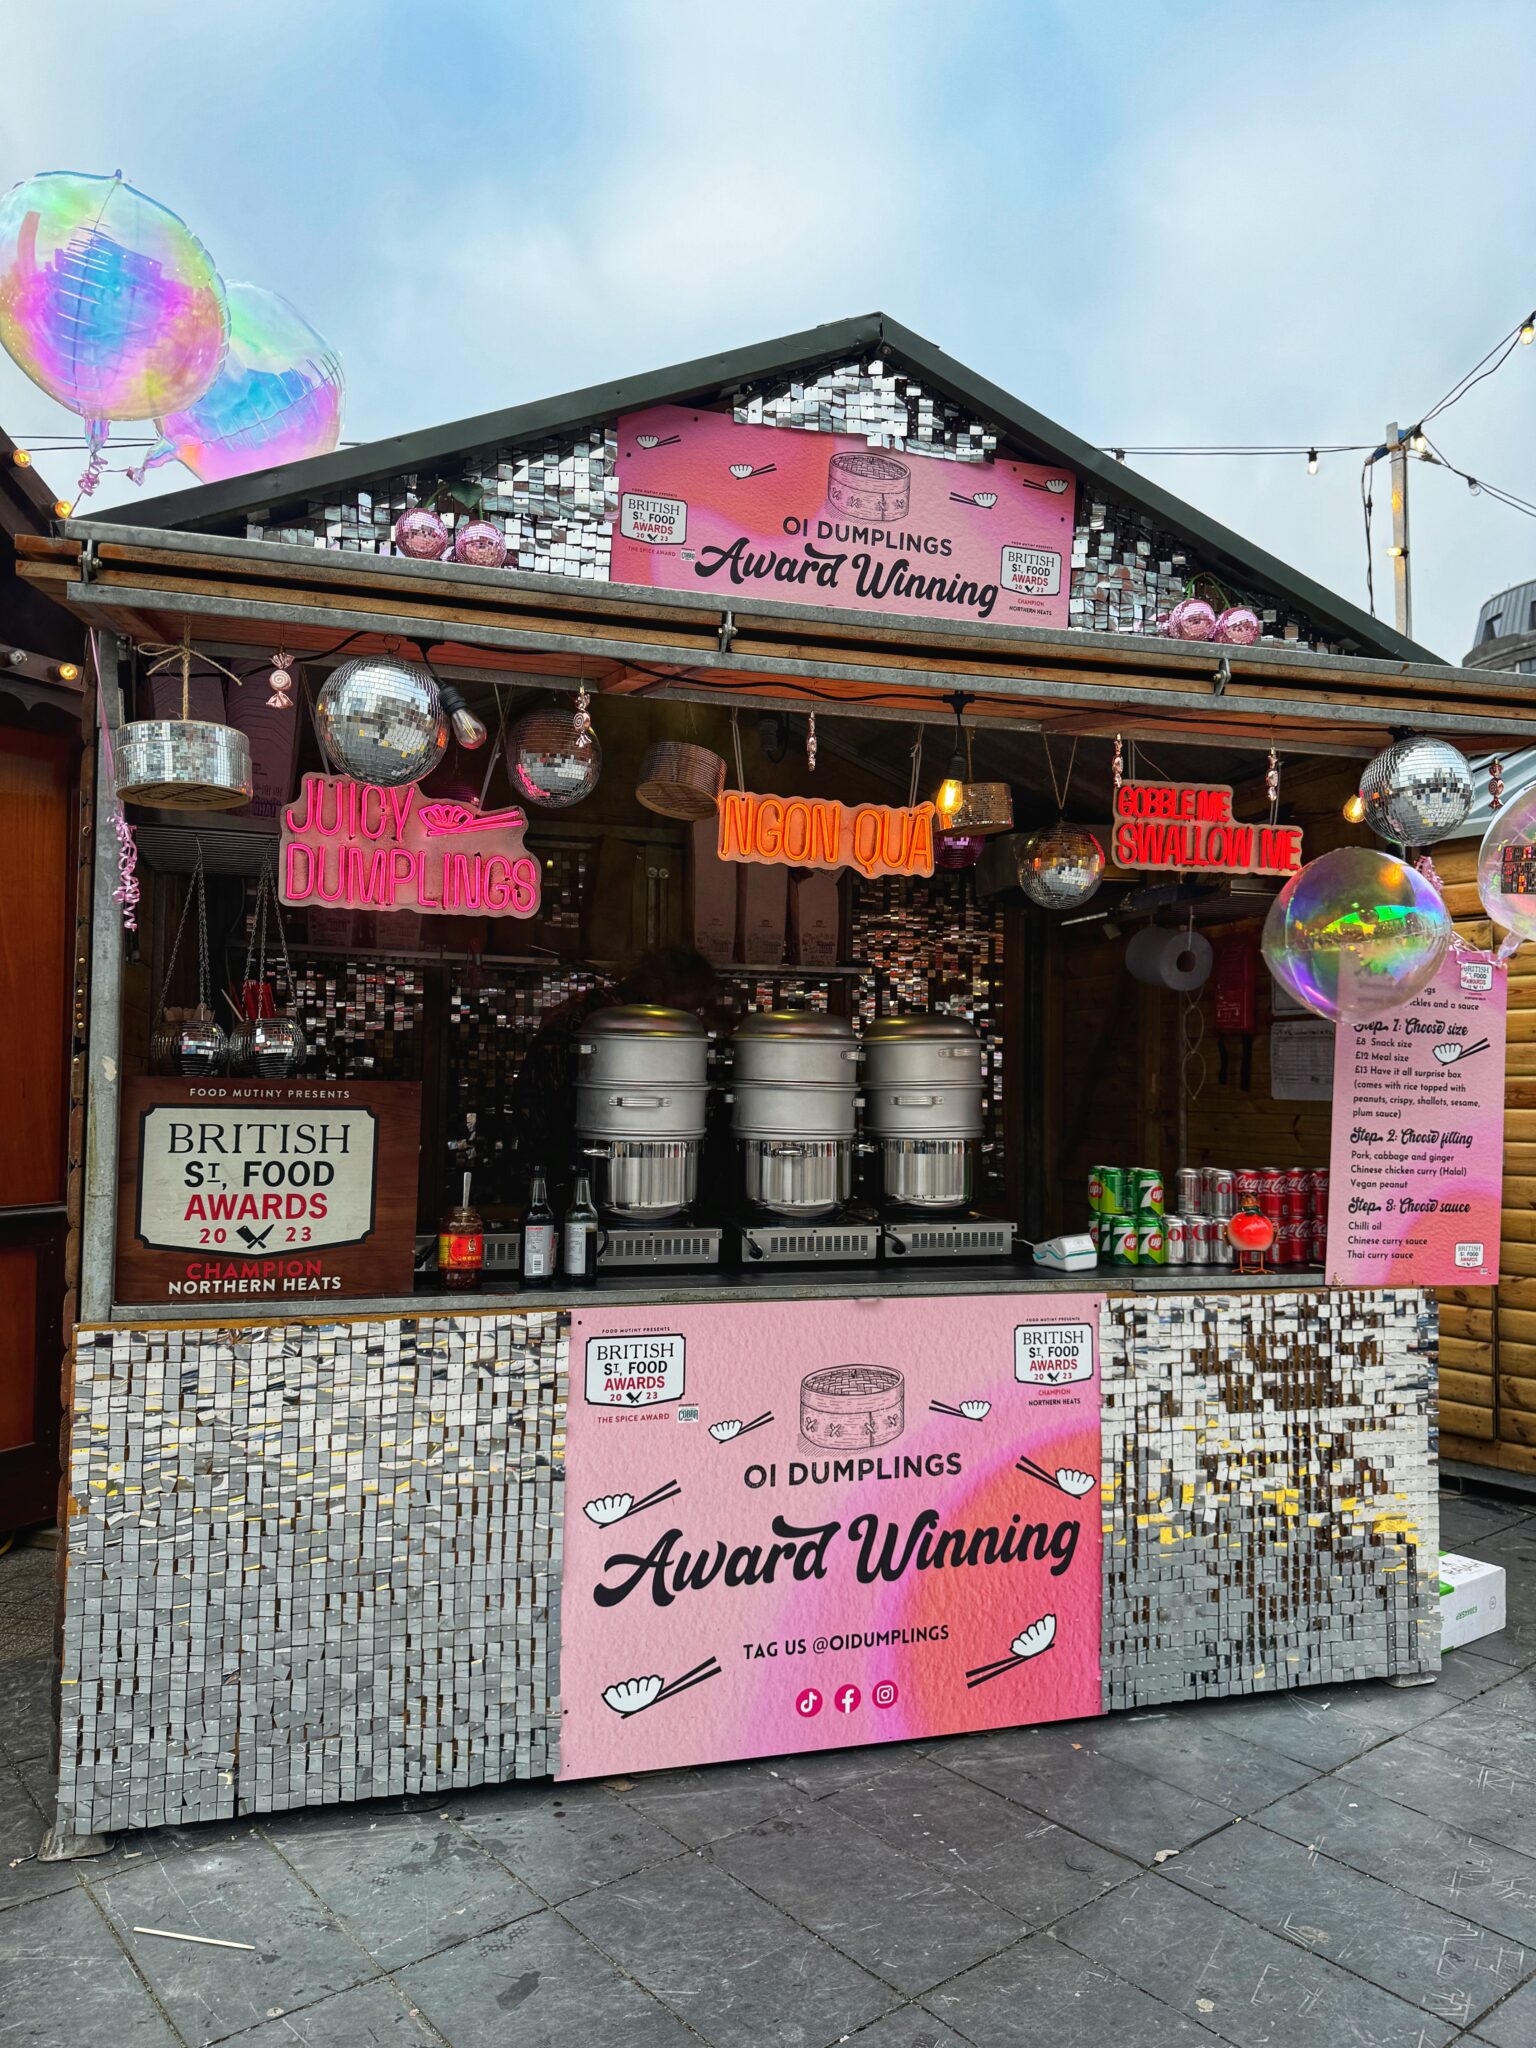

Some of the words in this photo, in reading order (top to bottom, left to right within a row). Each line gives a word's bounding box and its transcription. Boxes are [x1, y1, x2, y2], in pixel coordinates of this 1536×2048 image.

[628, 498, 680, 516] BRITISH
[649, 513, 675, 525] FOOD
[633, 522, 673, 535] AWARDS
[783, 516, 807, 535] OI
[818, 520, 953, 557] DUMPLINGS
[1008, 551, 1054, 567] BRITISH
[695, 536, 847, 585] Award
[852, 552, 999, 618] Winning
[1027, 566, 1050, 576] FOOD
[1012, 574, 1048, 586] AWARDS
[1018, 599, 1044, 607] CHAMPION
[1009, 606, 1036, 614] NORTHERN
[1037, 608, 1052, 616] HEATS
[286, 779, 415, 841] JUICY
[1117, 785, 1195, 820] GOBBLE
[1196, 790, 1231, 823] ME
[721, 795, 839, 863] NGON
[1117, 822, 1253, 867] SWALLOW
[1259, 828, 1302, 871] ME
[286, 843, 536, 912] DUMPLINGS
[1410, 998, 1431, 1007] ckles
[1434, 1000, 1448, 1009] and
[1405, 1018, 1445, 1035] Choose
[1447, 1023, 1468, 1036] size
[1371, 1038, 1395, 1047] Snack
[1397, 1040, 1412, 1048] size
[1355, 1051, 1369, 1060] £12
[1371, 1052, 1392, 1061] Meal
[1394, 1054, 1409, 1062] size
[1355, 1066, 1368, 1074] £13
[1370, 1067, 1391, 1076] Have
[1394, 1067, 1400, 1076] it
[1402, 1067, 1412, 1076] all
[1414, 1069, 1445, 1079] surprise
[1447, 1069, 1461, 1079] box
[189, 1088, 227, 1097] FOOD
[232, 1089, 282, 1098] MUTINY
[288, 1089, 350, 1099] PRESENTS
[1354, 1080, 1382, 1089] (comes
[1385, 1081, 1401, 1090] with
[1403, 1082, 1418, 1091] rice
[1420, 1083, 1448, 1093] topped
[1450, 1083, 1466, 1092] with
[1353, 1095, 1387, 1104] peanuts,
[1417, 1096, 1448, 1106] shallots,
[1353, 1108, 1373, 1117] plum
[1376, 1110, 1402, 1118] sauce)
[168, 1123, 351, 1154] BRITISH
[1386, 1129, 1398, 1142] 2:
[1401, 1128, 1440, 1145] Choose
[1440, 1131, 1473, 1149] filling
[1351, 1150, 1372, 1160] Pork,
[1374, 1151, 1409, 1162] cabbage
[1411, 1152, 1427, 1161] and
[1429, 1154, 1454, 1163] ginger
[243, 1160, 335, 1187] FOOD
[1350, 1164, 1382, 1174] Chinese
[1385, 1165, 1415, 1175] chicken
[1417, 1168, 1437, 1176] curry
[1440, 1167, 1467, 1177] (Halal)
[1350, 1179, 1377, 1190] Vegan
[1379, 1181, 1408, 1190] peanut
[184, 1192, 327, 1221] AWARDS
[1400, 1197, 1438, 1214] Choose
[1439, 1203, 1471, 1213] sauce
[1348, 1221, 1369, 1230] Chilli
[1371, 1221, 1382, 1230] oil
[199, 1228, 227, 1244] 20
[285, 1226, 312, 1242] 23
[1347, 1236, 1380, 1245] Chinese
[1382, 1238, 1403, 1246] curry
[1347, 1250, 1365, 1259] Thai
[1367, 1251, 1388, 1260] curry
[186, 1260, 322, 1280] CHAMPION
[168, 1278, 276, 1295] NORTHERN
[283, 1276, 341, 1292] HEATS
[1023, 1330, 1084, 1345] BRITISH
[597, 1343, 674, 1360] BRITISH
[1048, 1346, 1079, 1358] FOOD
[629, 1361, 667, 1374] FOOD
[1030, 1359, 1078, 1372] AWARDS
[604, 1376, 665, 1391] AWARDS
[598, 1416, 613, 1424] THE
[640, 1413, 670, 1421] AWARD
[744, 1463, 776, 1489] OI
[789, 1452, 962, 1486] DUMPLINGS
[593, 1515, 841, 1608] Award
[848, 1509, 1081, 1585] Winning
[743, 1642, 778, 1660] TAG
[785, 1638, 806, 1655] US
[812, 1625, 949, 1655] @OIDUMPLINGS
